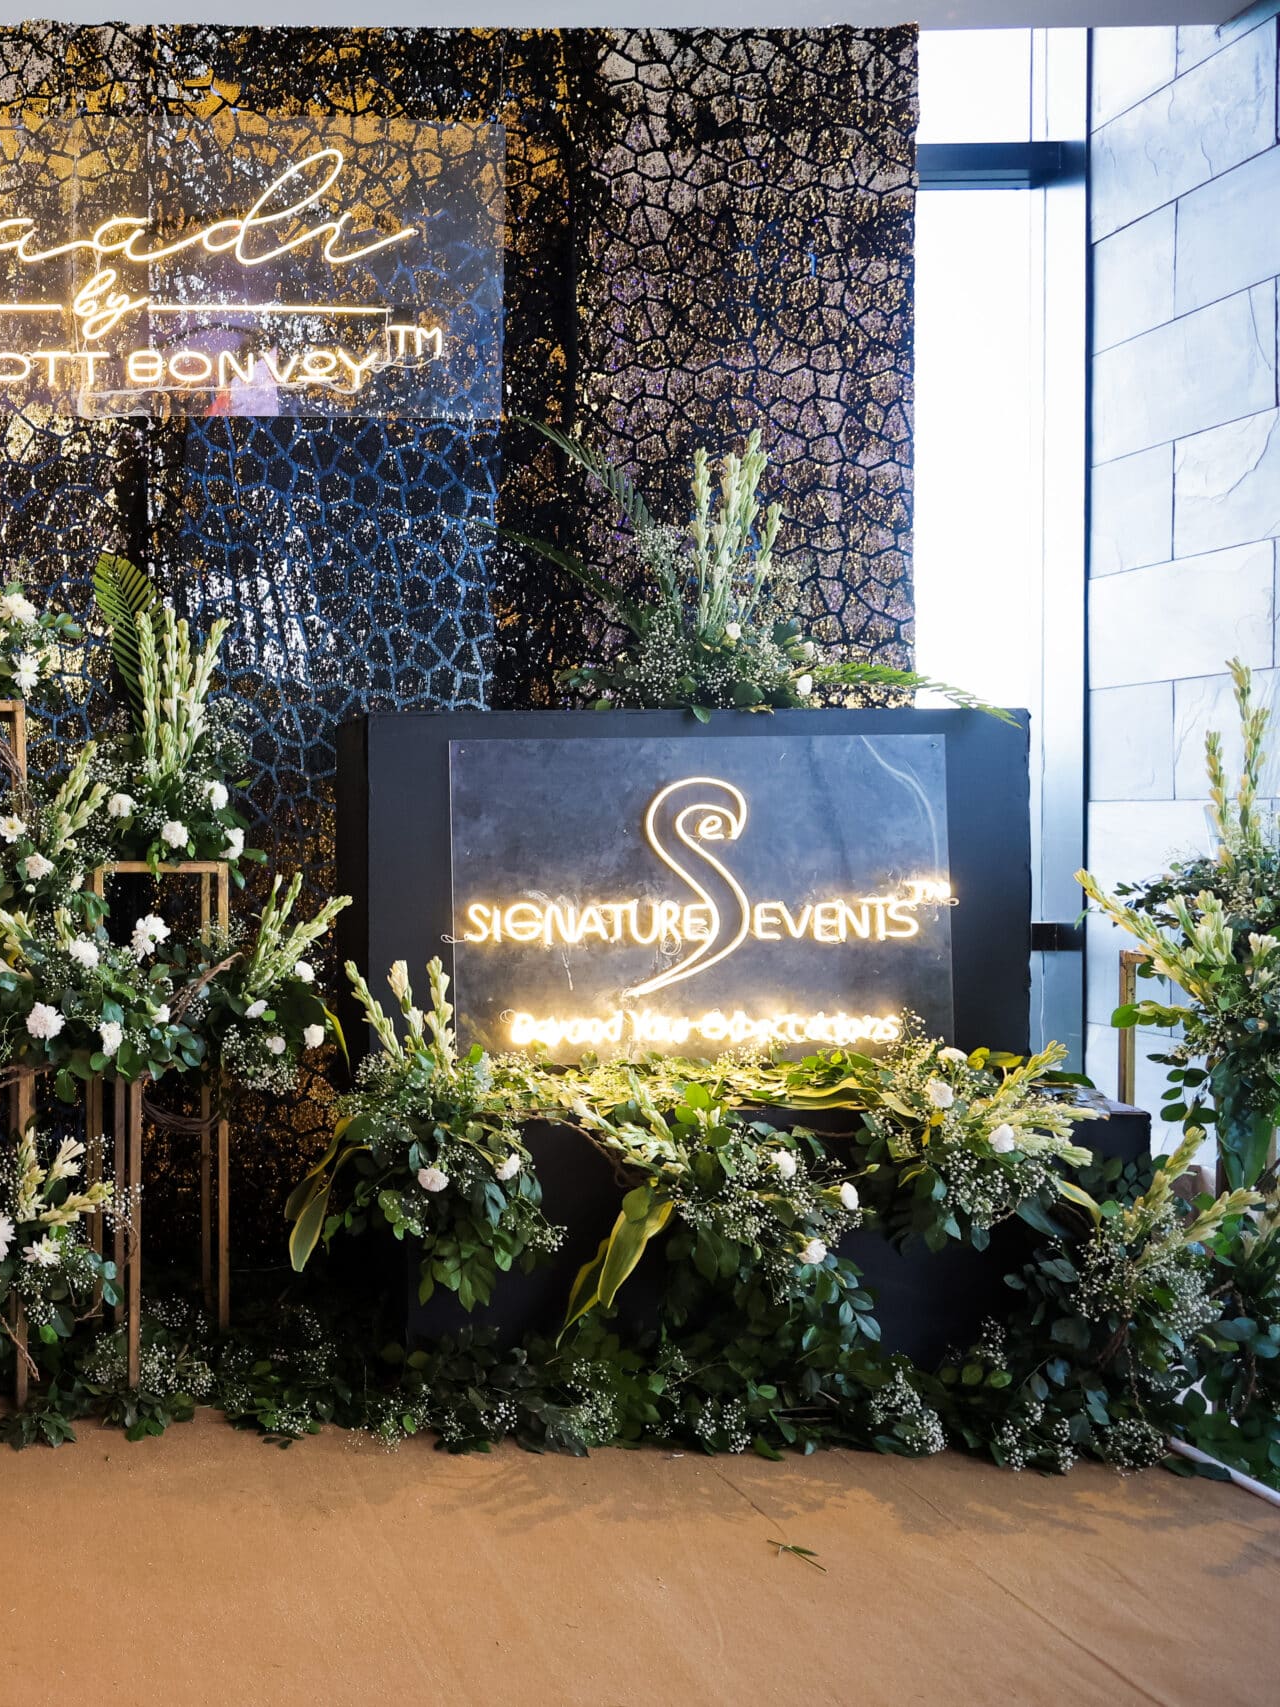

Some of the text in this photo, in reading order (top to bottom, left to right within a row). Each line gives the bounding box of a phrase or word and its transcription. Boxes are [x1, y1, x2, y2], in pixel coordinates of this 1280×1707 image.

[72, 268, 151, 340] by
[126, 350, 375, 394] BONVOY
[464, 899, 712, 945] SIGNATURE
[752, 899, 920, 942] EVENTS
